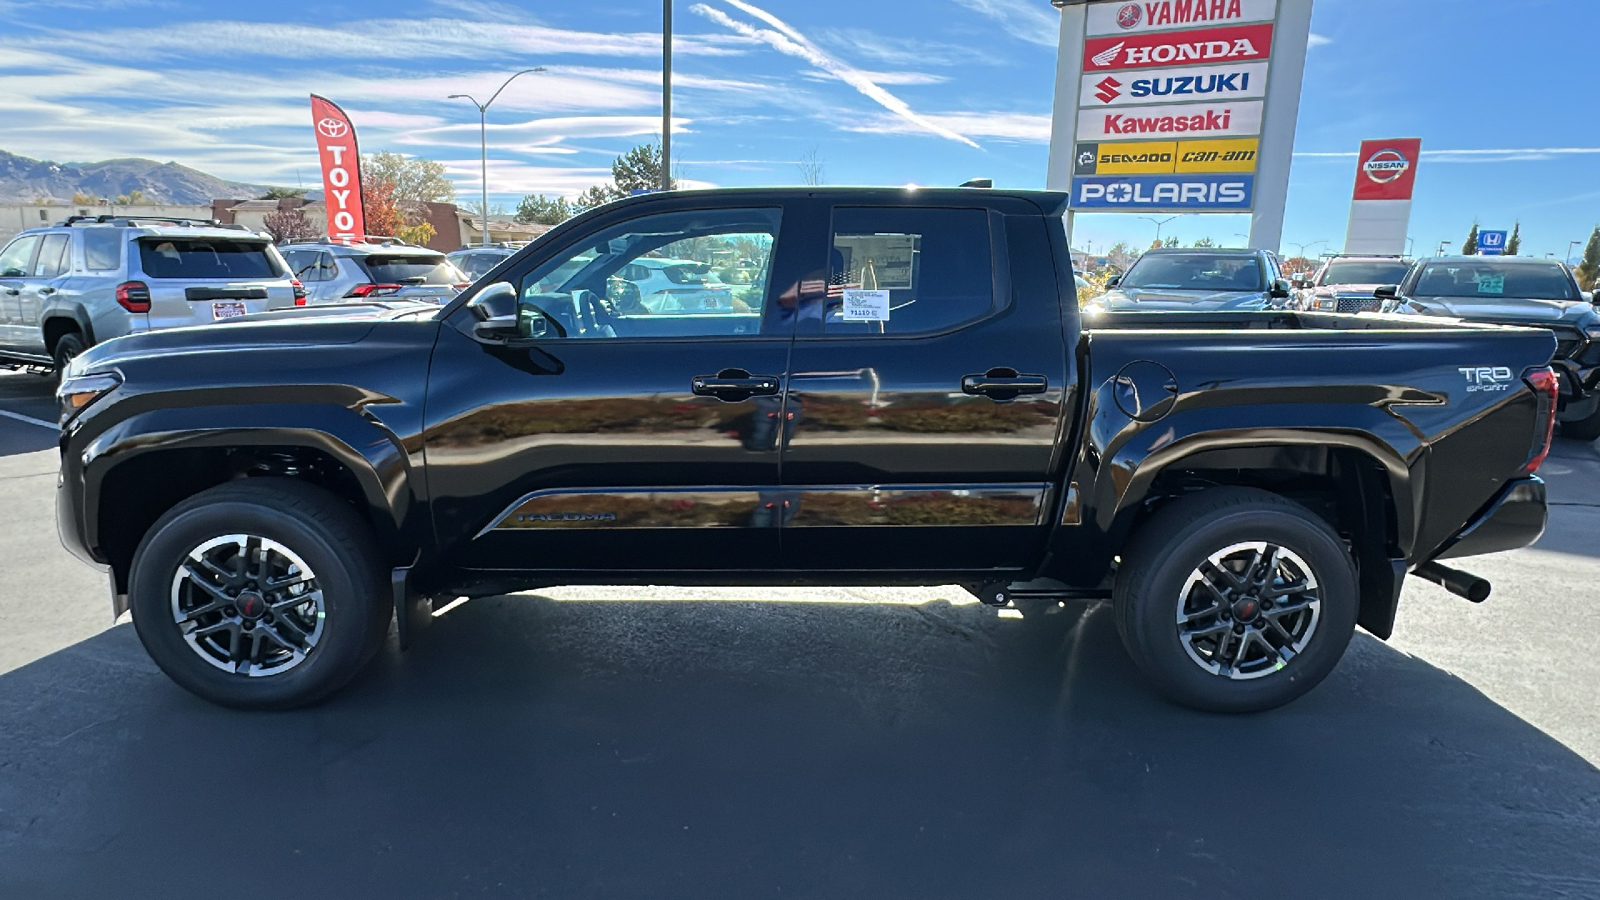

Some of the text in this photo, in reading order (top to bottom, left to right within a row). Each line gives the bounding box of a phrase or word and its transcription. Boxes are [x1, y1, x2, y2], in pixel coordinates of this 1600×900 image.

[1145, 0, 1241, 26] YAMAHA
[1124, 38, 1259, 65] HONDA
[1130, 72, 1250, 98] SUZUKI
[1103, 110, 1231, 134] Kawasaki
[1367, 161, 1405, 170] NISSAN
[326, 145, 356, 246] TOYOT
[1079, 182, 1246, 203] POLARIS
[1458, 366, 1513, 384] TRD
[1466, 384, 1509, 392] SPORT
[517, 512, 617, 522] TACOMA
